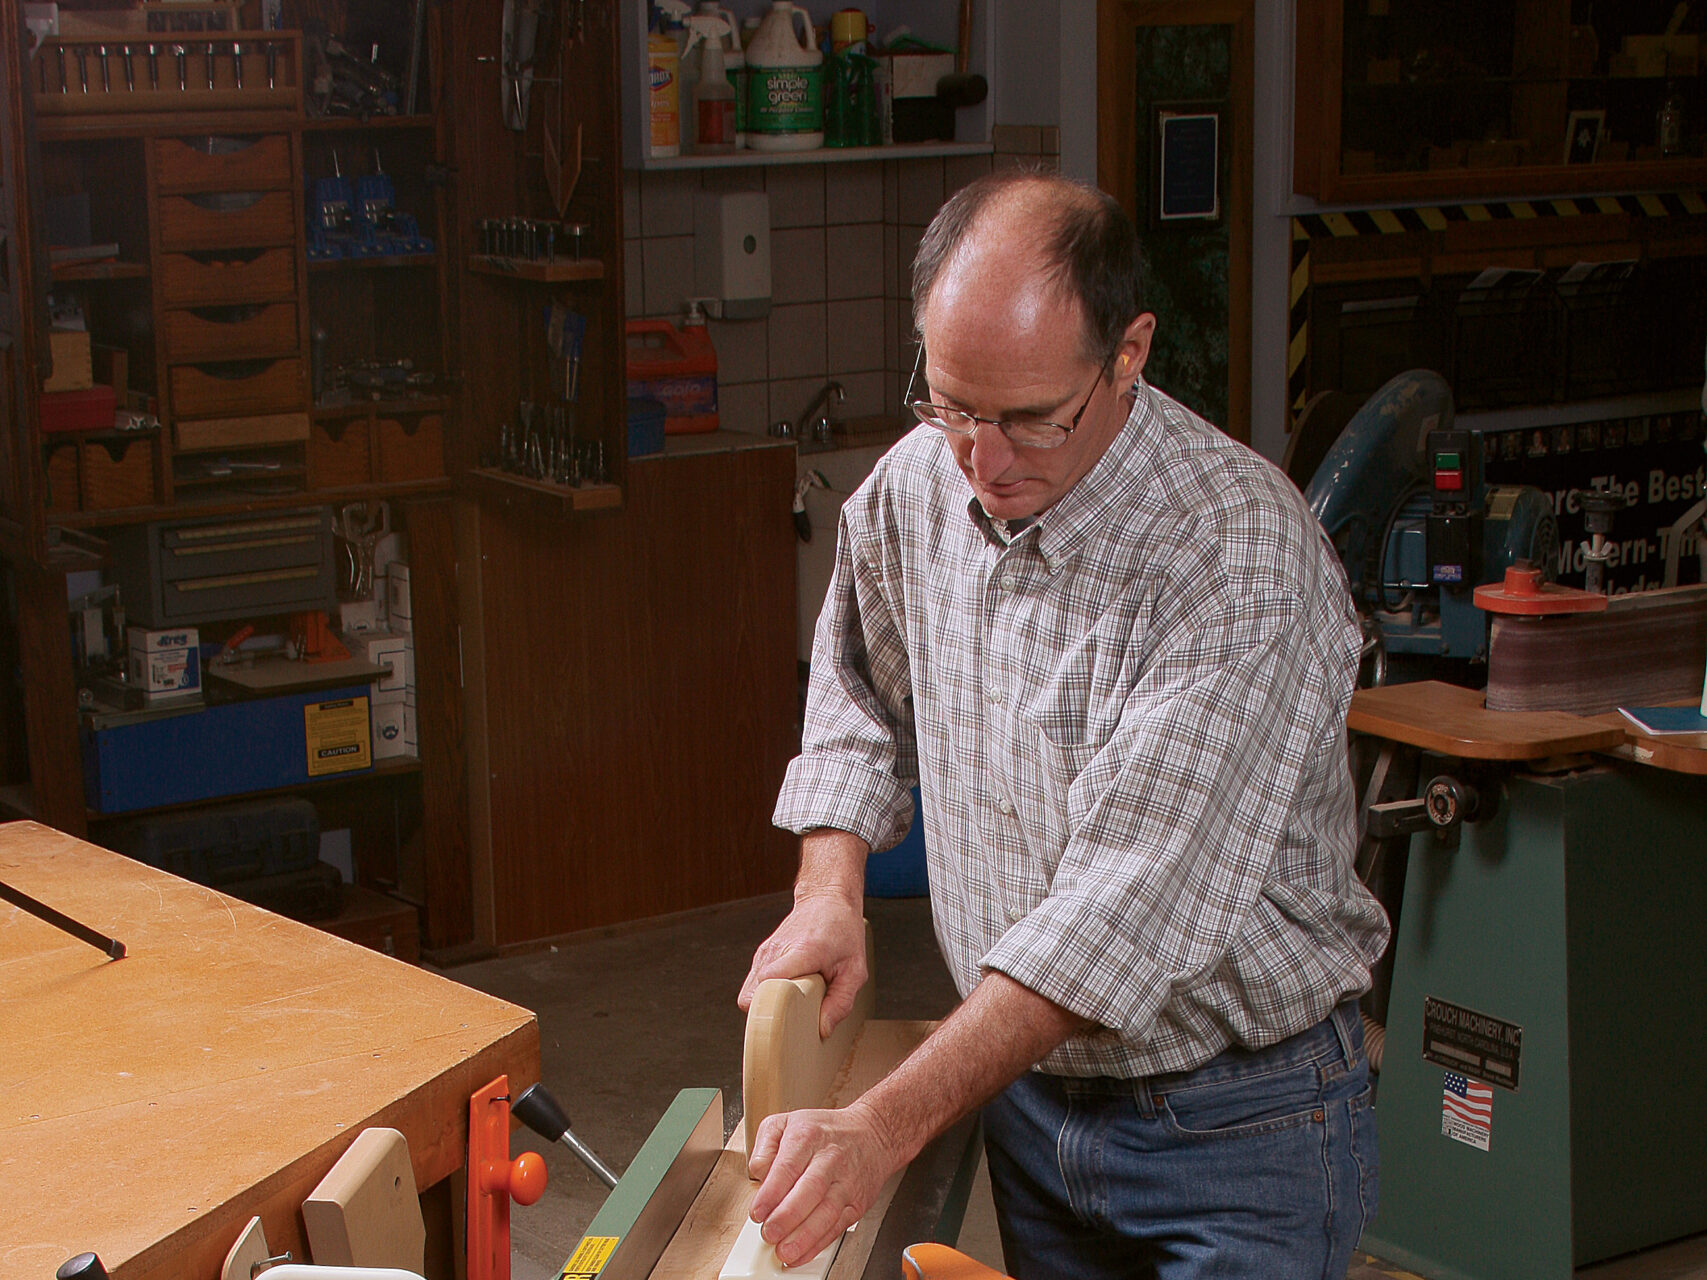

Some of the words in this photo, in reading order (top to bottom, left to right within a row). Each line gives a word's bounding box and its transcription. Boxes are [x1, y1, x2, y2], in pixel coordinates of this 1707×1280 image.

[767, 75, 808, 92] simple
[768, 90, 807, 105] green
[1647, 465, 1705, 504] Best
[321, 746, 358, 757] CAUTION
[1426, 1000, 1458, 1026] CROUCH
